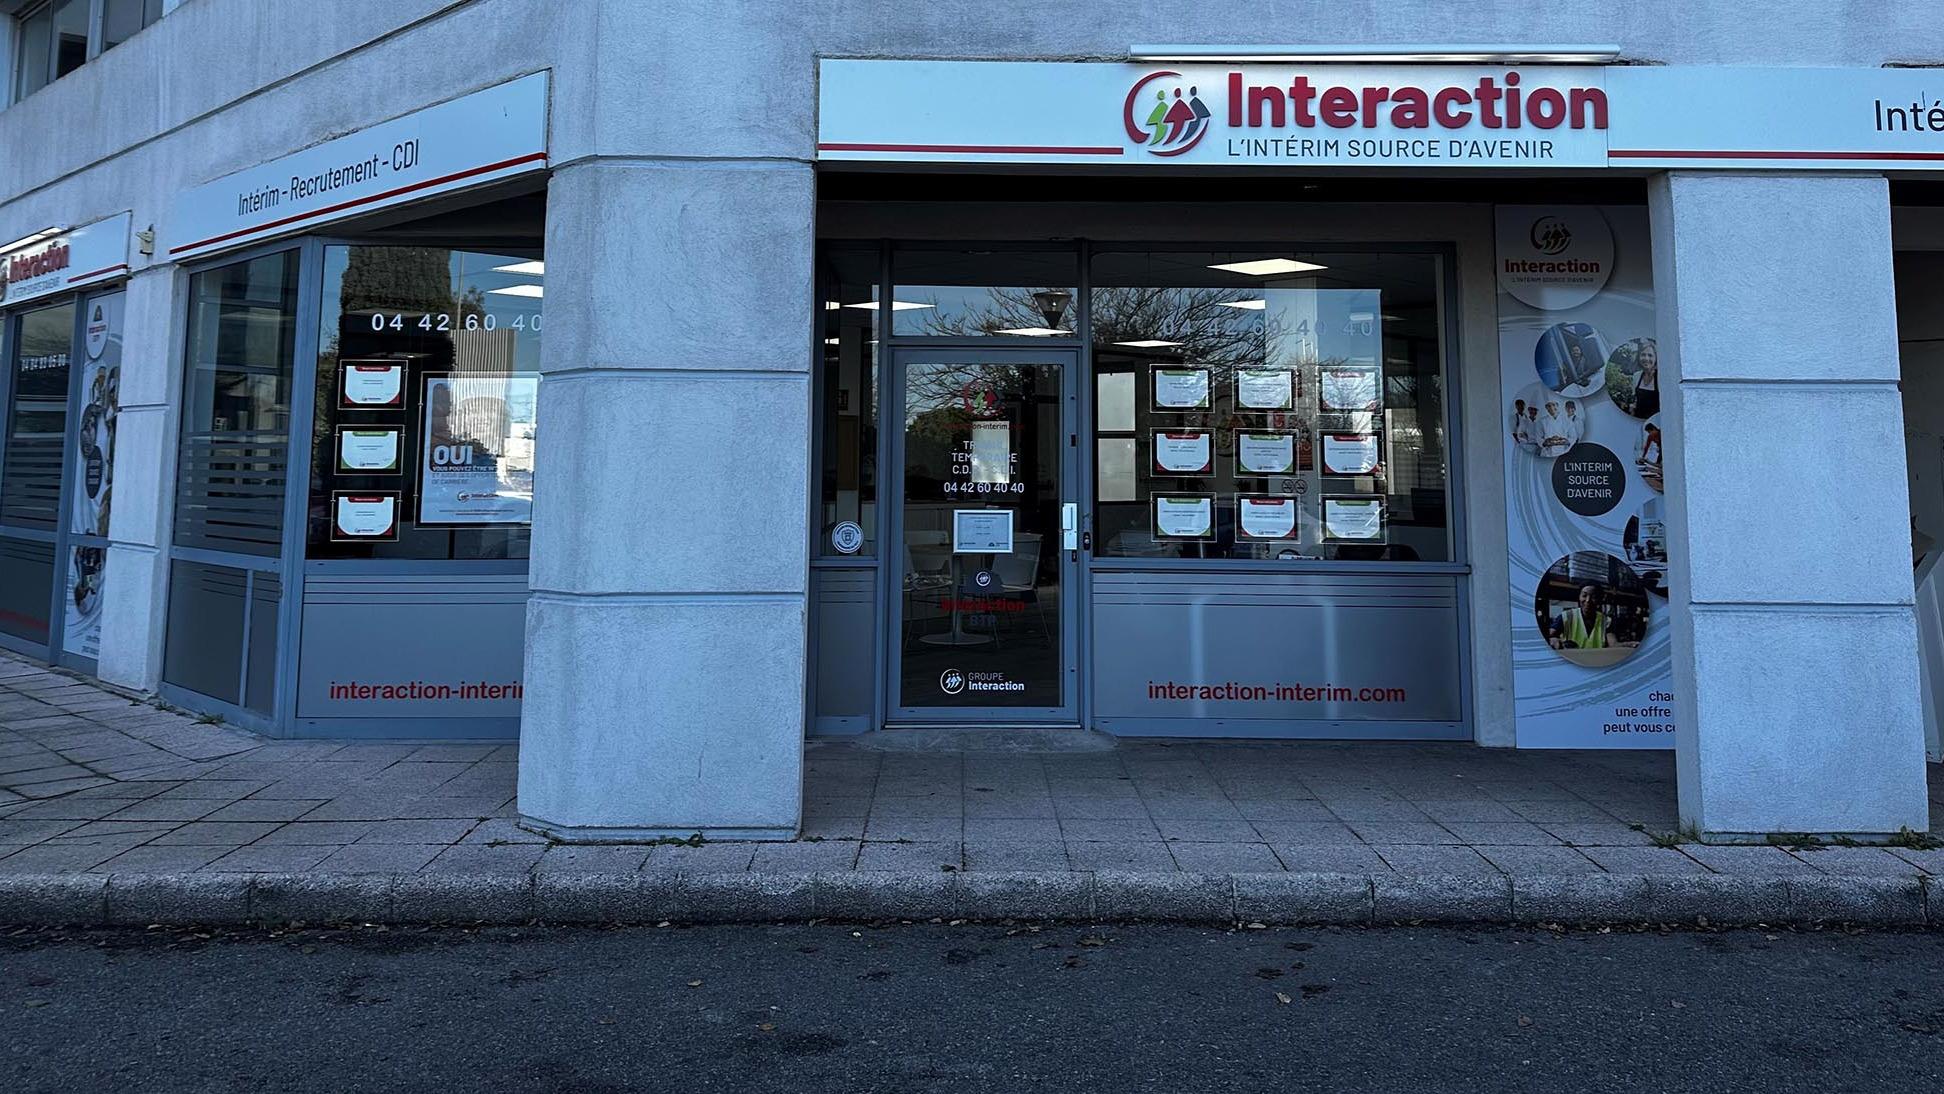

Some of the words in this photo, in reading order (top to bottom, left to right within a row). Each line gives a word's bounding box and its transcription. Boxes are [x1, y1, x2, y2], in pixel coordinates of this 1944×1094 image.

[1228, 71, 1609, 130] Interaction
[1227, 134, 1340, 158] L'INTÉRIM
[1347, 139, 1441, 158] SOURCE
[1448, 140, 1554, 159] D'AVENIR
[238, 184, 280, 217] Intérim
[290, 153, 379, 202] Recrutement
[392, 138, 420, 172] CDI
[1504, 258, 1601, 274] Interaction
[371, 313, 404, 332] 04
[418, 313, 450, 332] 42
[465, 313, 497, 332] 60
[511, 314, 543, 332] 40
[433, 445, 473, 465] OUI
[1563, 462, 1613, 472] L'INTERIM
[943, 482, 958, 493] 04
[960, 482, 975, 493] 42
[977, 482, 991, 493] 60
[993, 482, 1008, 493] 40
[1010, 482, 1025, 493] 40
[1568, 475, 1610, 486] SOURCE
[1567, 488, 1613, 499] D'AVENIR
[968, 672, 1005, 681] GROUPE
[330, 681, 524, 700] interaction-interi
[968, 680, 1026, 692] Interaction
[1148, 681, 1406, 702] interaction-interim.com
[1615, 707, 1639, 717] une
[1640, 706, 1672, 718] offre
[1603, 722, 1632, 736] peut
[1633, 724, 1663, 733] vous
